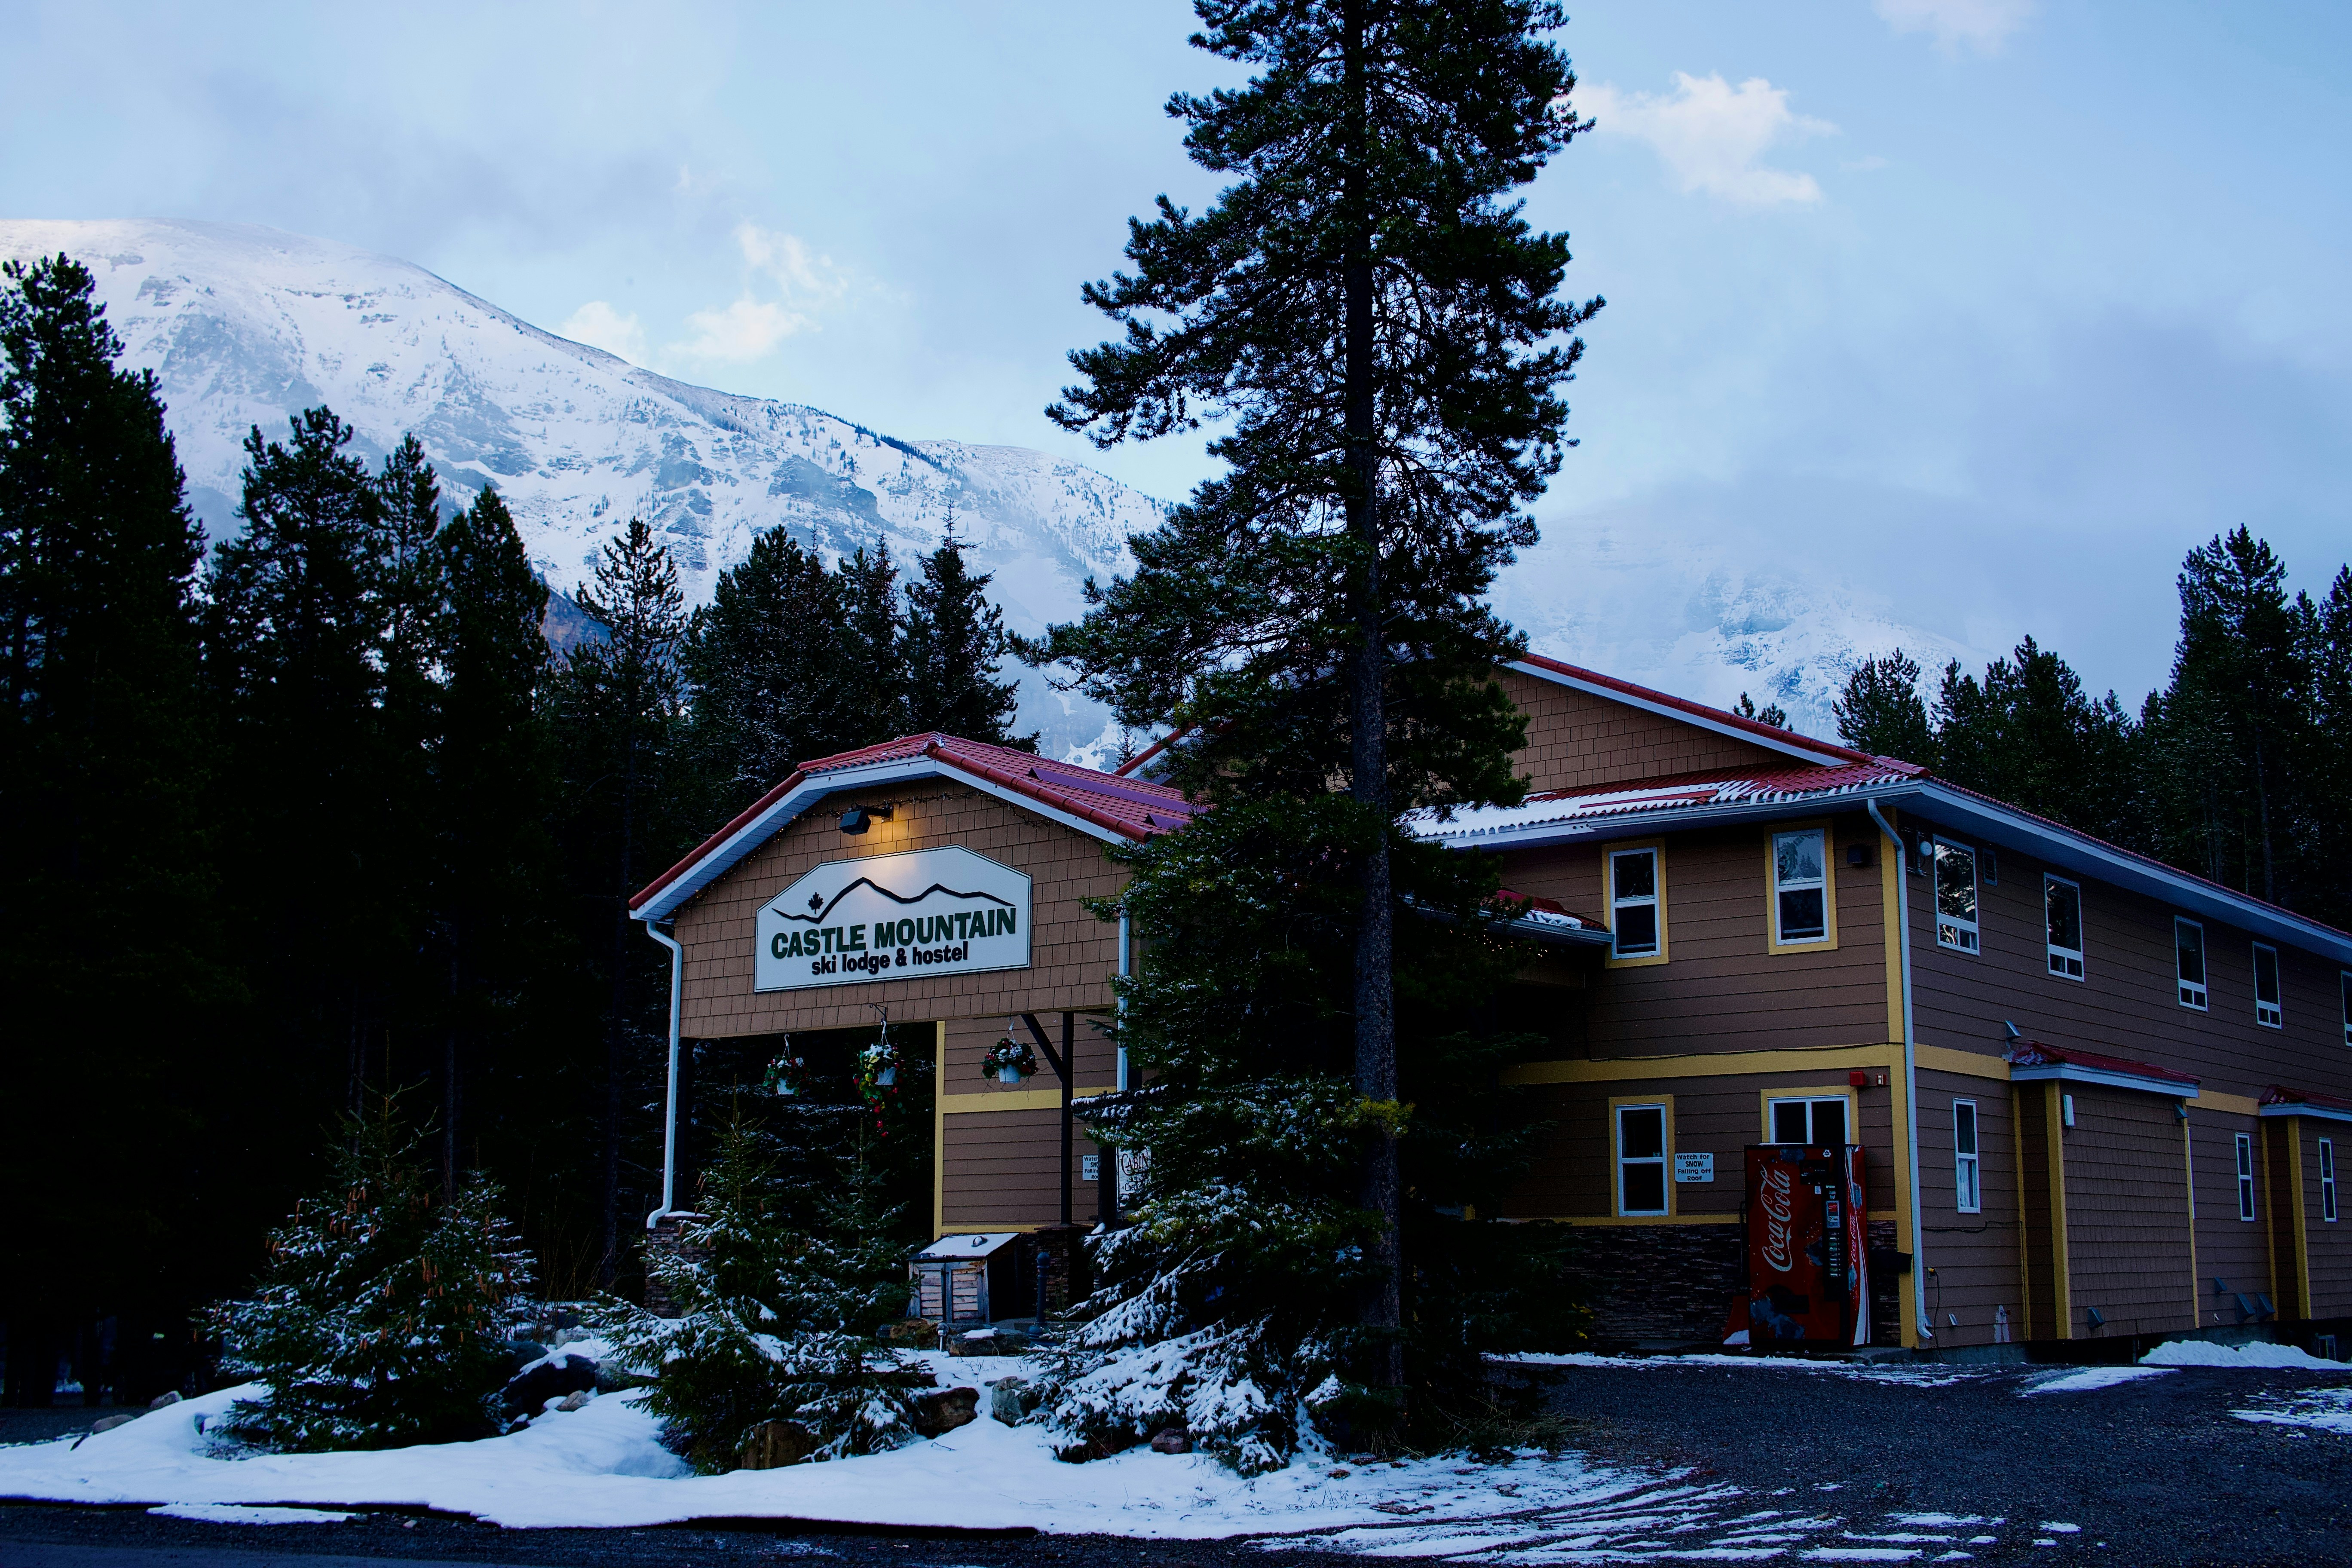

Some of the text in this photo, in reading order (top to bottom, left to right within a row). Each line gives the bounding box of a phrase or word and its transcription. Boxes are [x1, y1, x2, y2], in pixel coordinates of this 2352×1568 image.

[772, 908, 1016, 959] CASTLE MOUNTAIN
[812, 941, 968, 975] ski lodge & hostel
